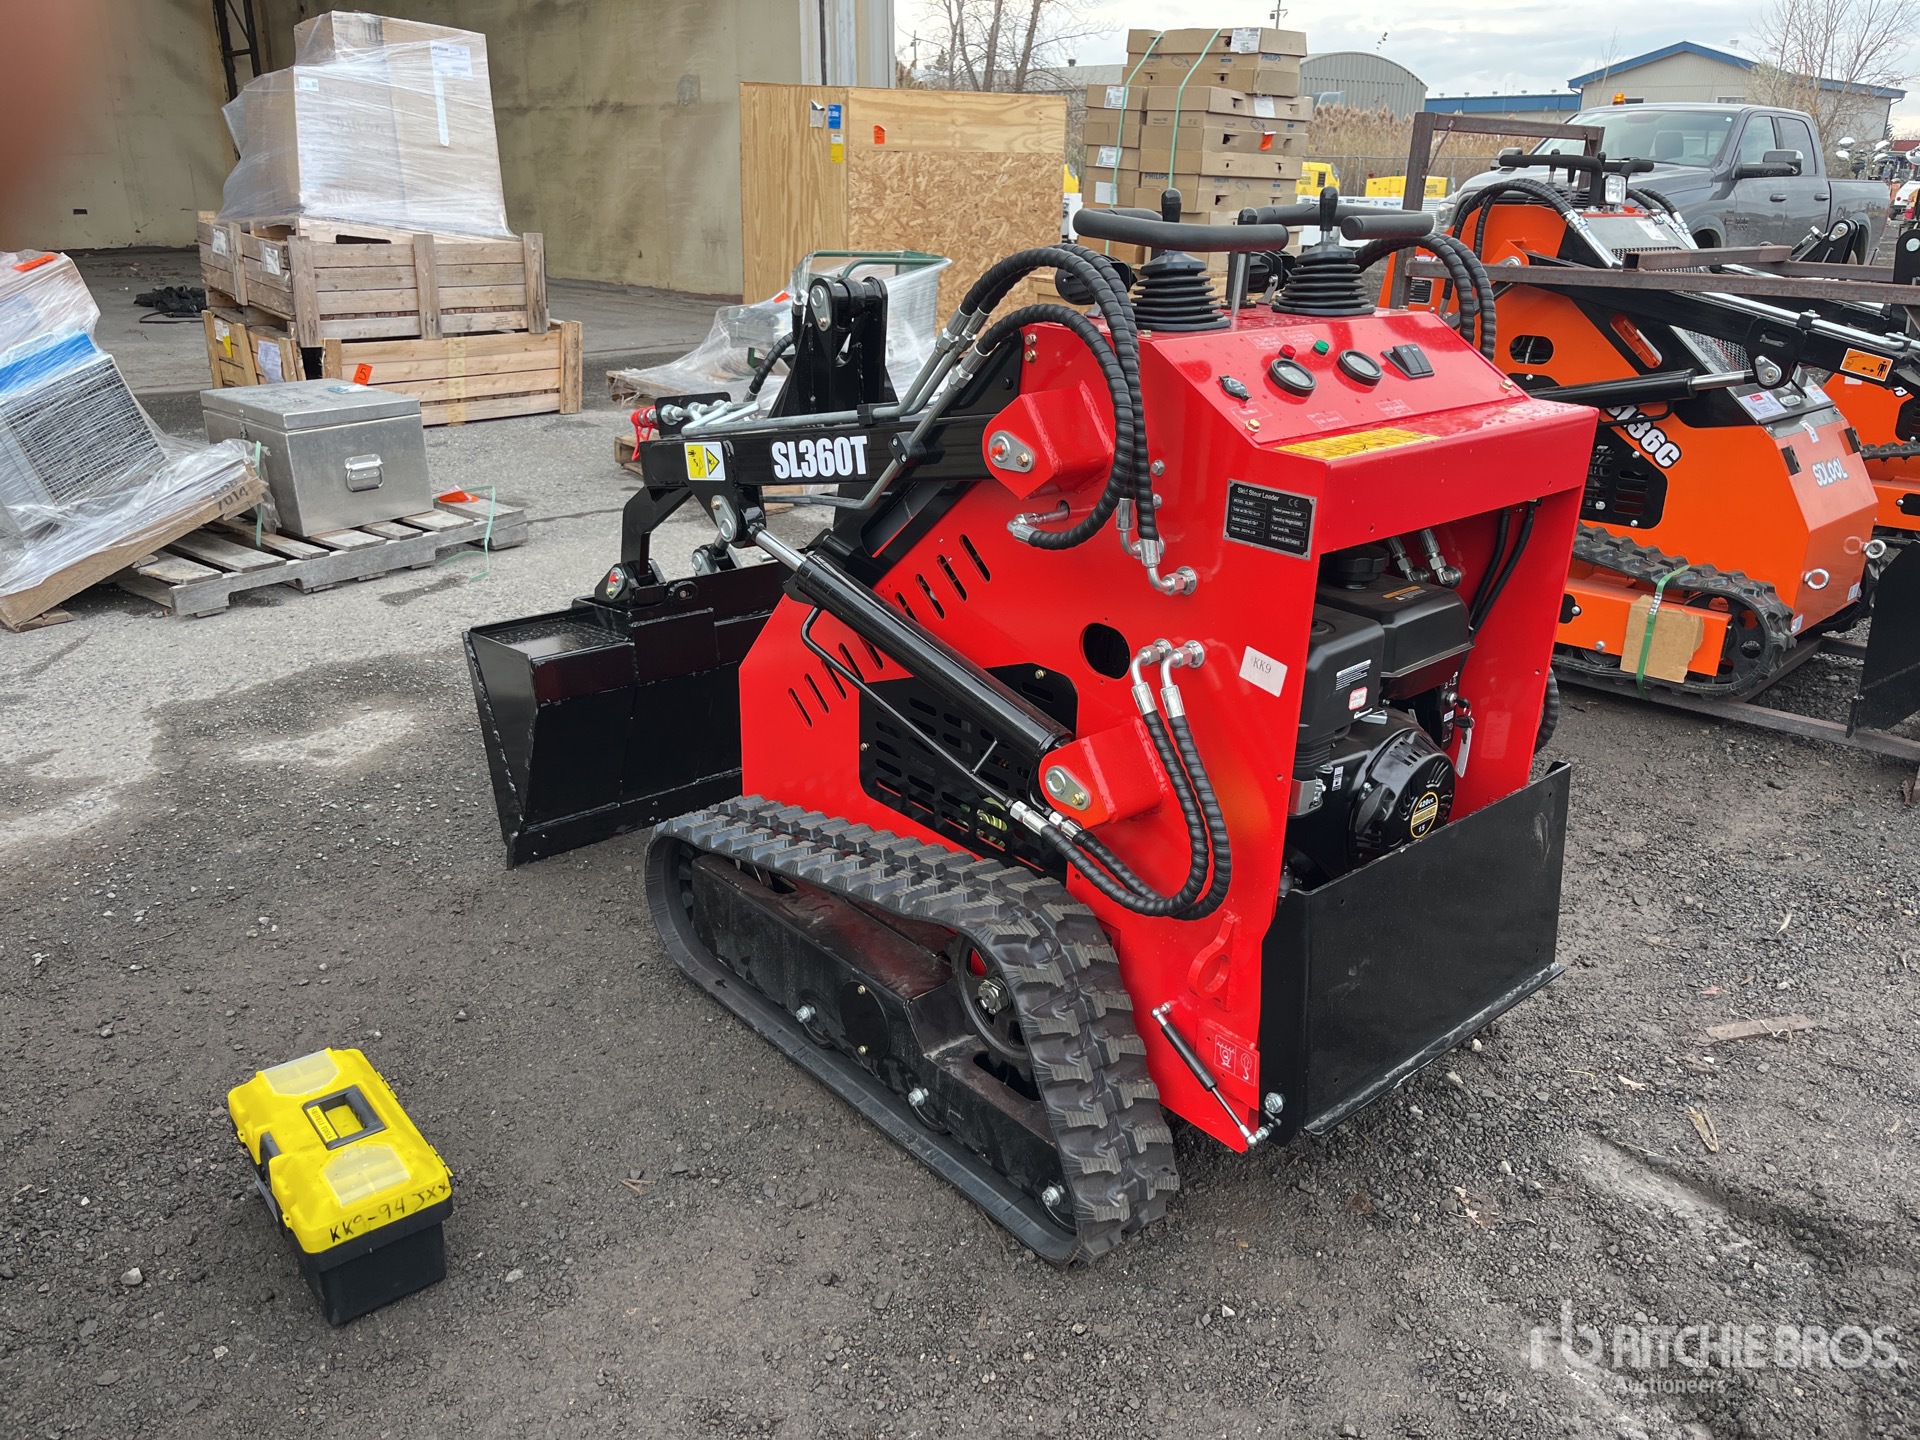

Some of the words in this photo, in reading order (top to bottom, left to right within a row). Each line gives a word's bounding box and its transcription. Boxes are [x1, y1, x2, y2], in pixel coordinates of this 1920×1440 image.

[1144, 172, 1169, 180] PHILIPS
[771, 435, 868, 480] SL360T
[1237, 486, 1249, 495] Skid
[1262, 492, 1280, 502] Loader
[1252, 656, 1272, 674] KK9
